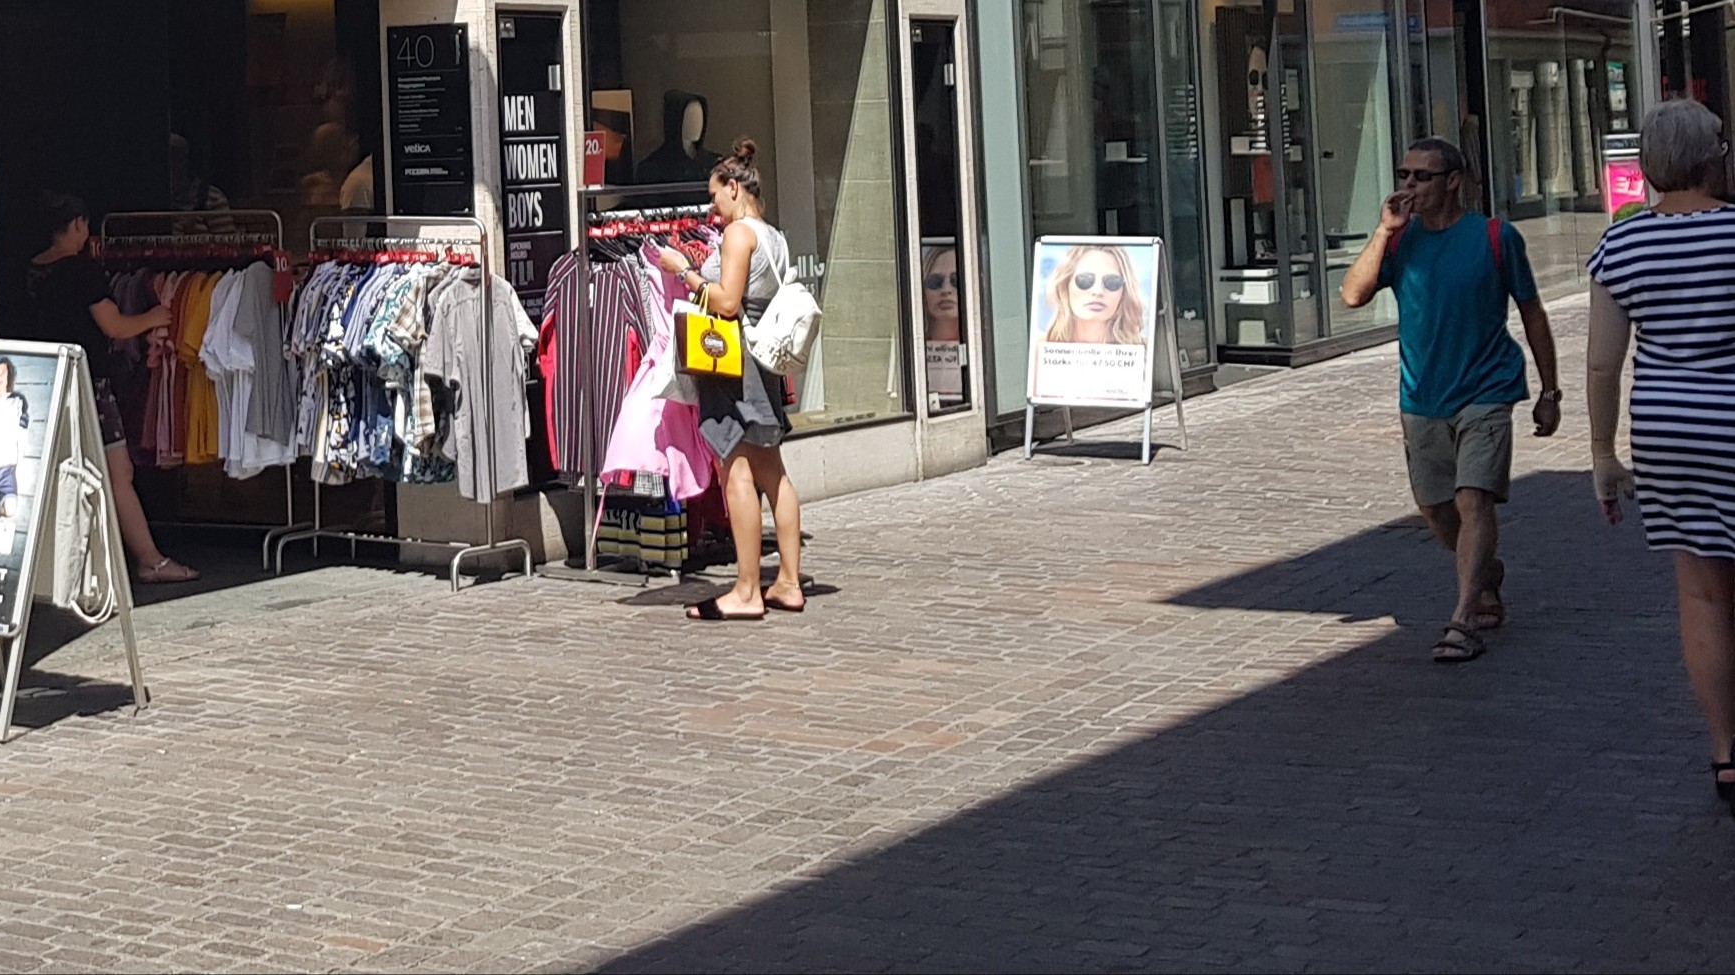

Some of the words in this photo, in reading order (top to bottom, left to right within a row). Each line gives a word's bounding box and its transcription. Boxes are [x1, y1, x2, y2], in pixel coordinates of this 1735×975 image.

[396, 34, 435, 68] 40
[504, 95, 536, 131] MEN
[504, 142, 558, 180] WOMEN
[508, 191, 544, 229] BOYS
[275, 255, 288, 273] 10
